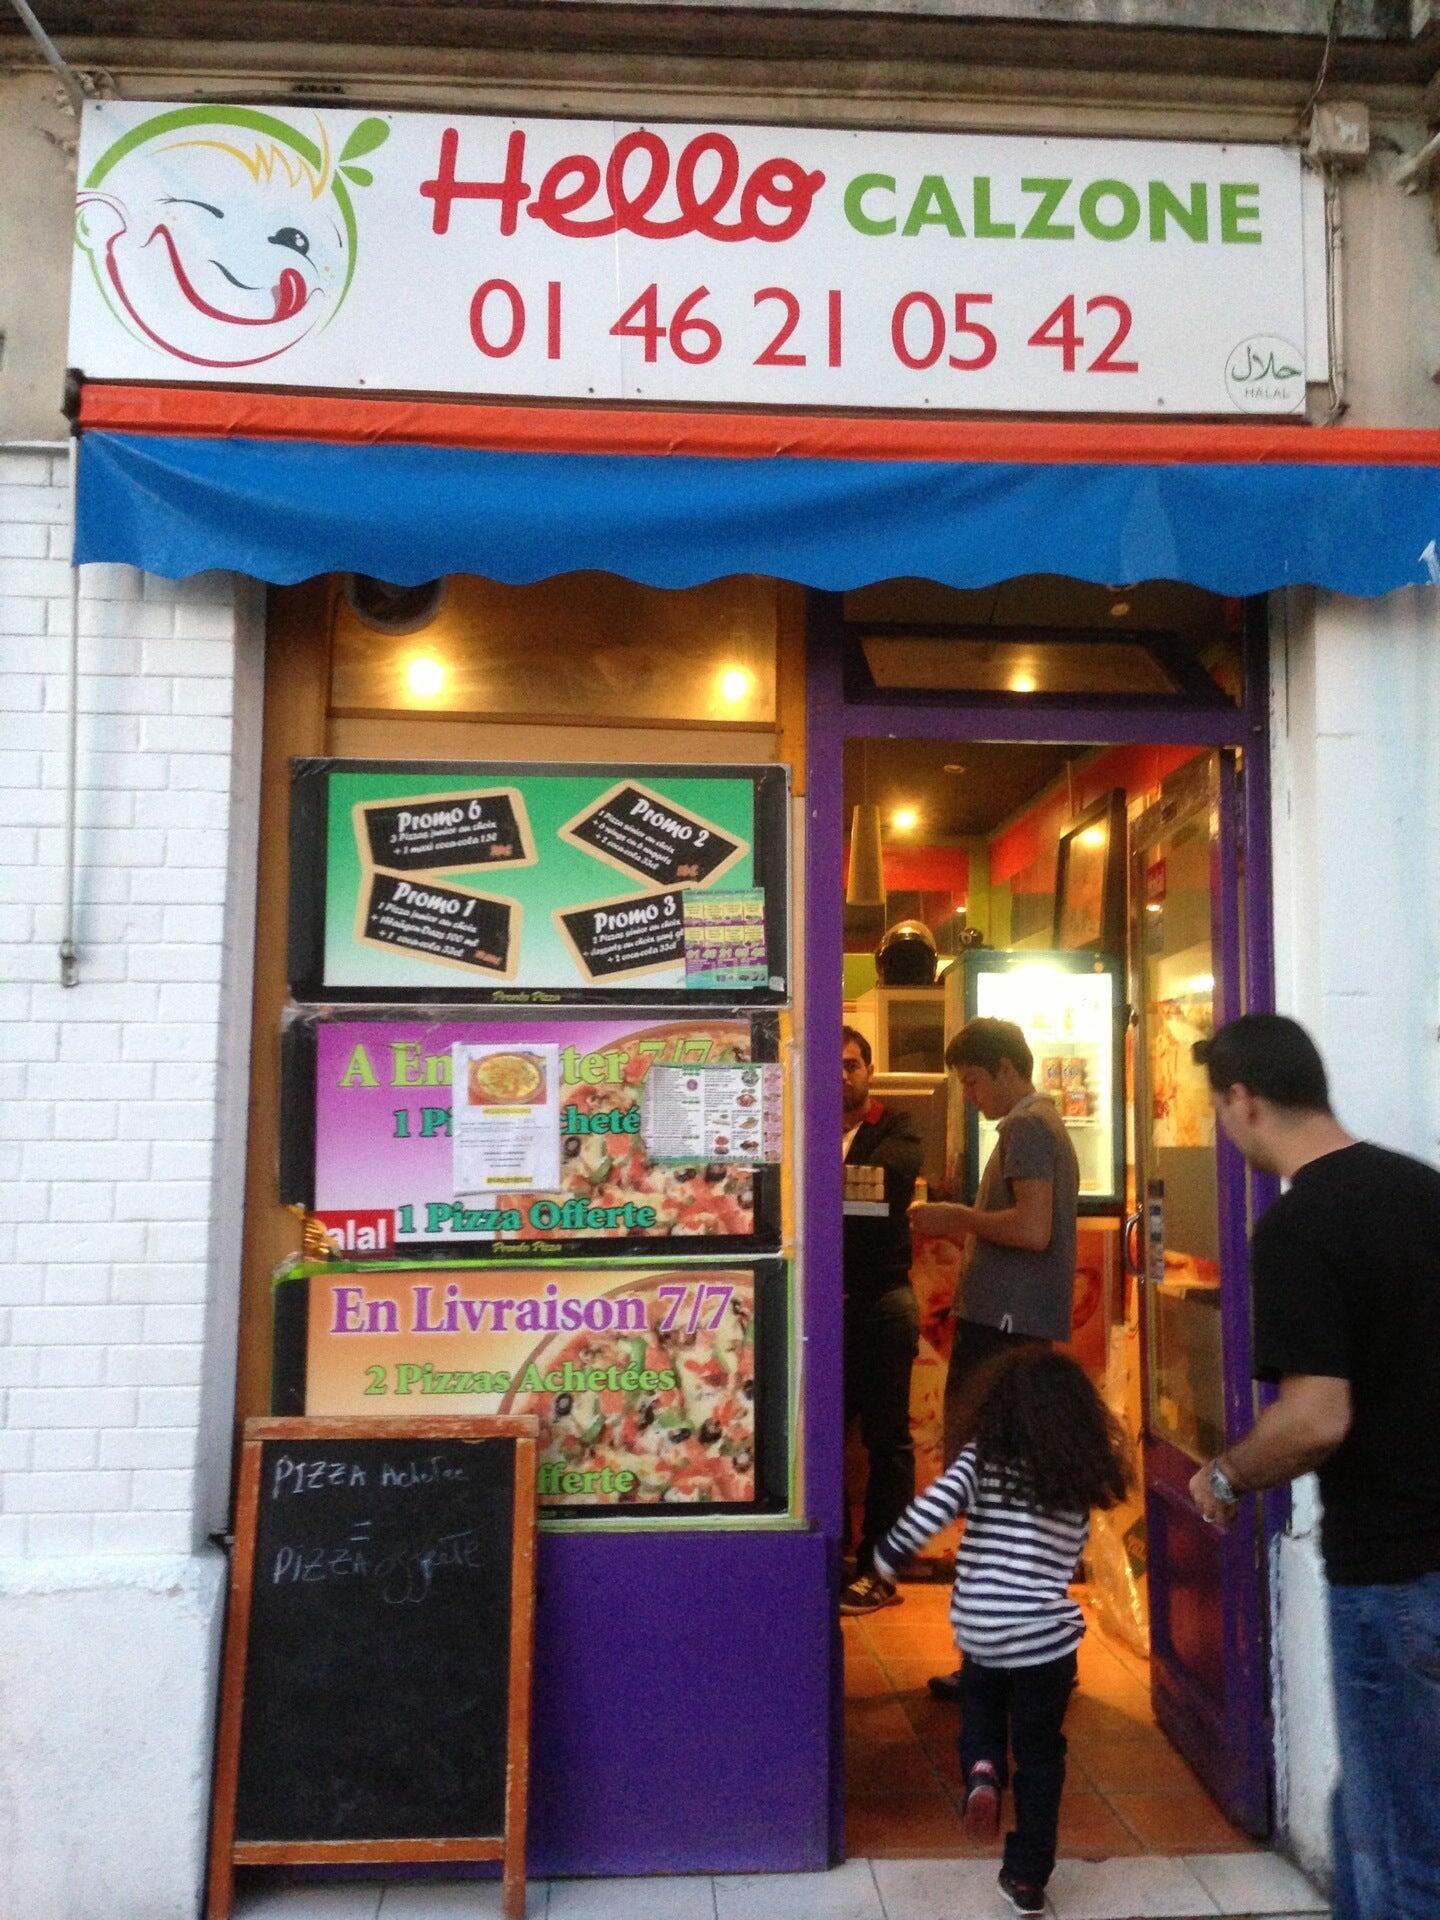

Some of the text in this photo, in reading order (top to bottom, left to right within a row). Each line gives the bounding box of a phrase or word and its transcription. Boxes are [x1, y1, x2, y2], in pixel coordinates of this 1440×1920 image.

[421, 127, 1263, 244] Hello CALZONE
[470, 278, 561, 359] 01
[891, 291, 997, 371] 05
[1028, 294, 1139, 373] 42
[1231, 346, 1303, 382] حلال
[1245, 387, 1290, 399] HALAL
[397, 800, 481, 833] Promo 6
[630, 798, 710, 848] Promo 2
[655, 840, 675, 854] choix
[392, 882, 477, 917] Promo 1
[594, 904, 659, 934] Promo
[663, 895, 676, 916] 3
[634, 936, 656, 947] choix
[340, 1042, 380, 1088] A
[393, 1108, 411, 1137] 1
[398, 1197, 657, 1233] 1 Pizza Offerte
[325, 1218, 388, 1251] alal
[331, 1283, 735, 1335] En Livraison 7/7
[365, 1360, 678, 1395] 2 Pizzas Achetées
[271, 1455, 367, 1499] PIZZA
[536, 1461, 637, 1495] fferte
[272, 1546, 370, 1585] PIZZA
